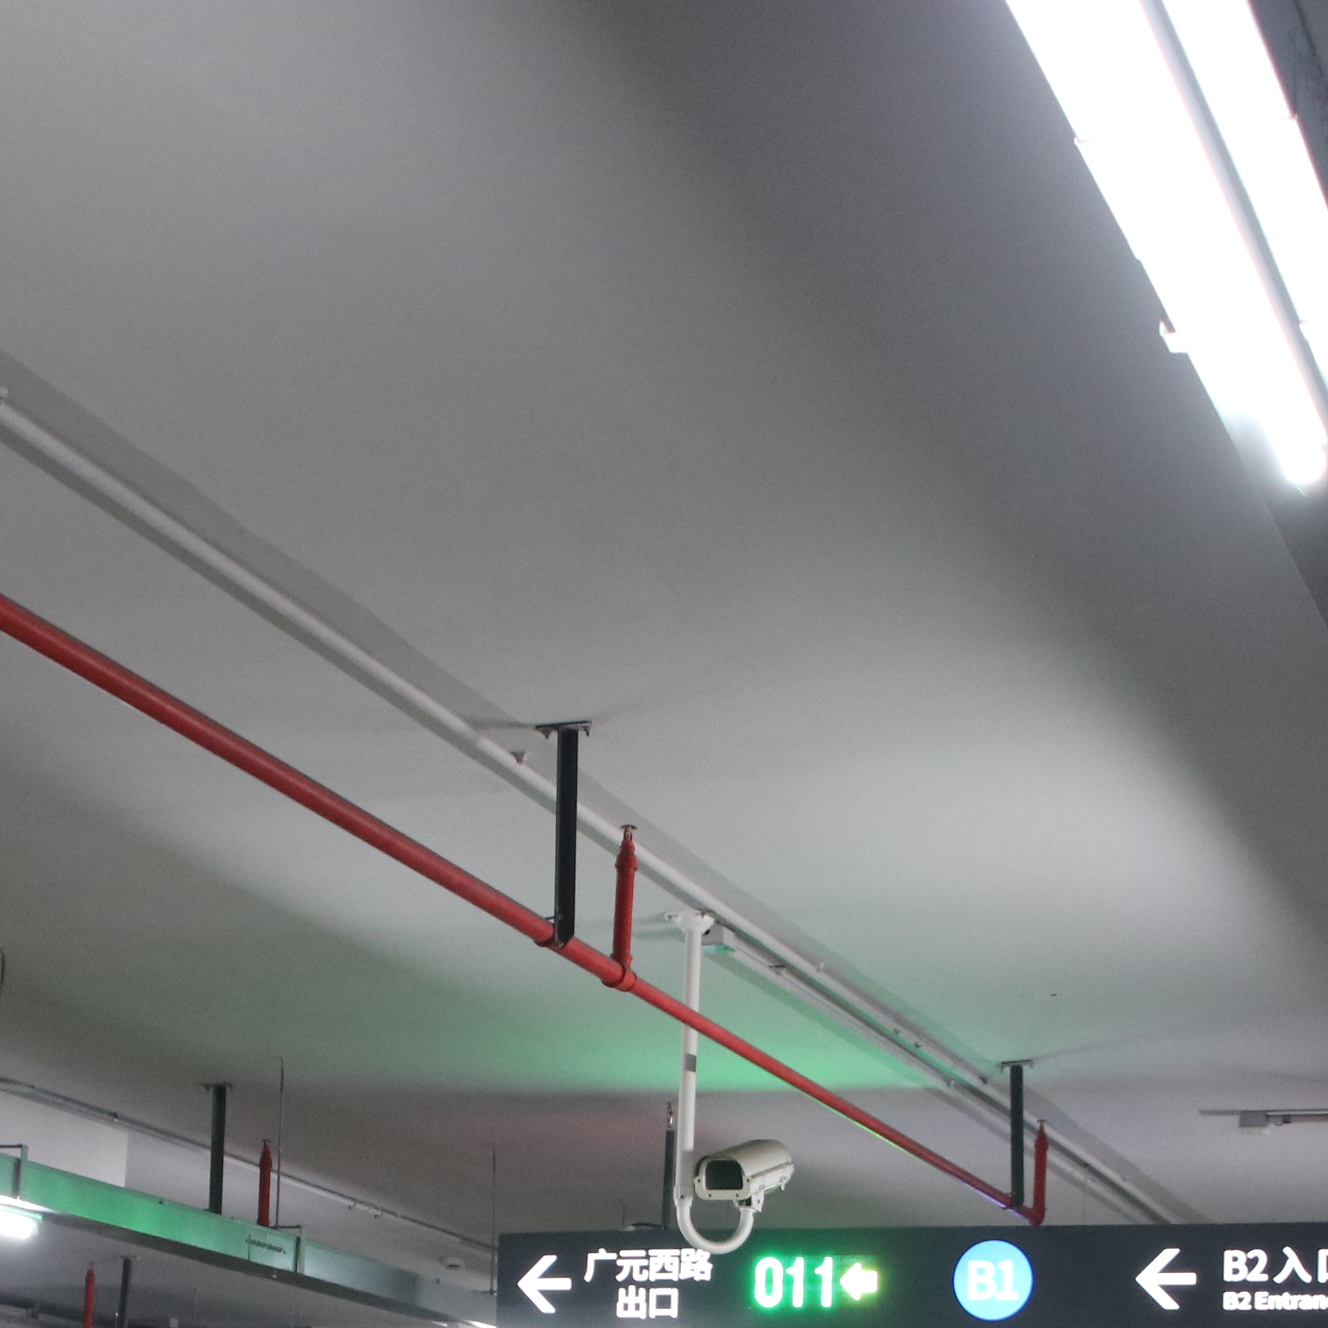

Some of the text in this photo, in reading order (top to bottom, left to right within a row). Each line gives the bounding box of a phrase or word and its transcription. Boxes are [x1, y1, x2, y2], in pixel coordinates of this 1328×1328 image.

[584, 1248, 713, 1281] 广元西路
[967, 1260, 1019, 1300] B1
[754, 1256, 834, 1308] 011
[616, 1285, 679, 1319] 出口
[1223, 1292, 1252, 1310] B2
